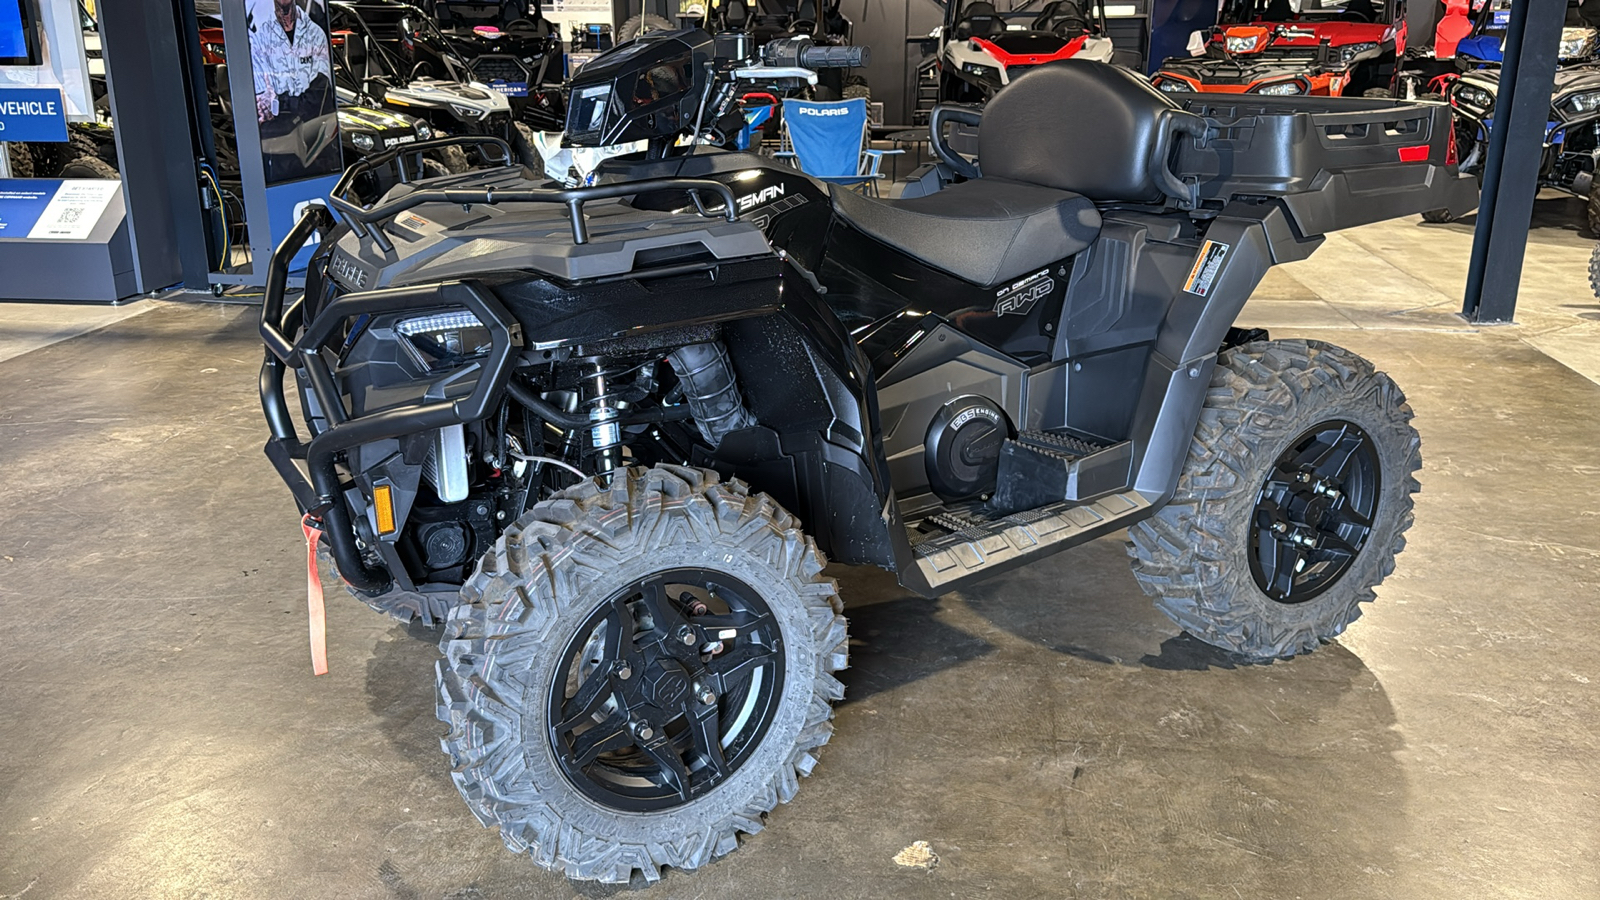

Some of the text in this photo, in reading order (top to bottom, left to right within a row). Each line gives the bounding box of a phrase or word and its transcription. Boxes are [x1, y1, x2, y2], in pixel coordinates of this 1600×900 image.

[799, 107, 849, 117] POLARIS
[384, 135, 416, 147] POLARIS
[997, 279, 1055, 318] AWD
[951, 408, 1000, 430] EBS ENGINE
